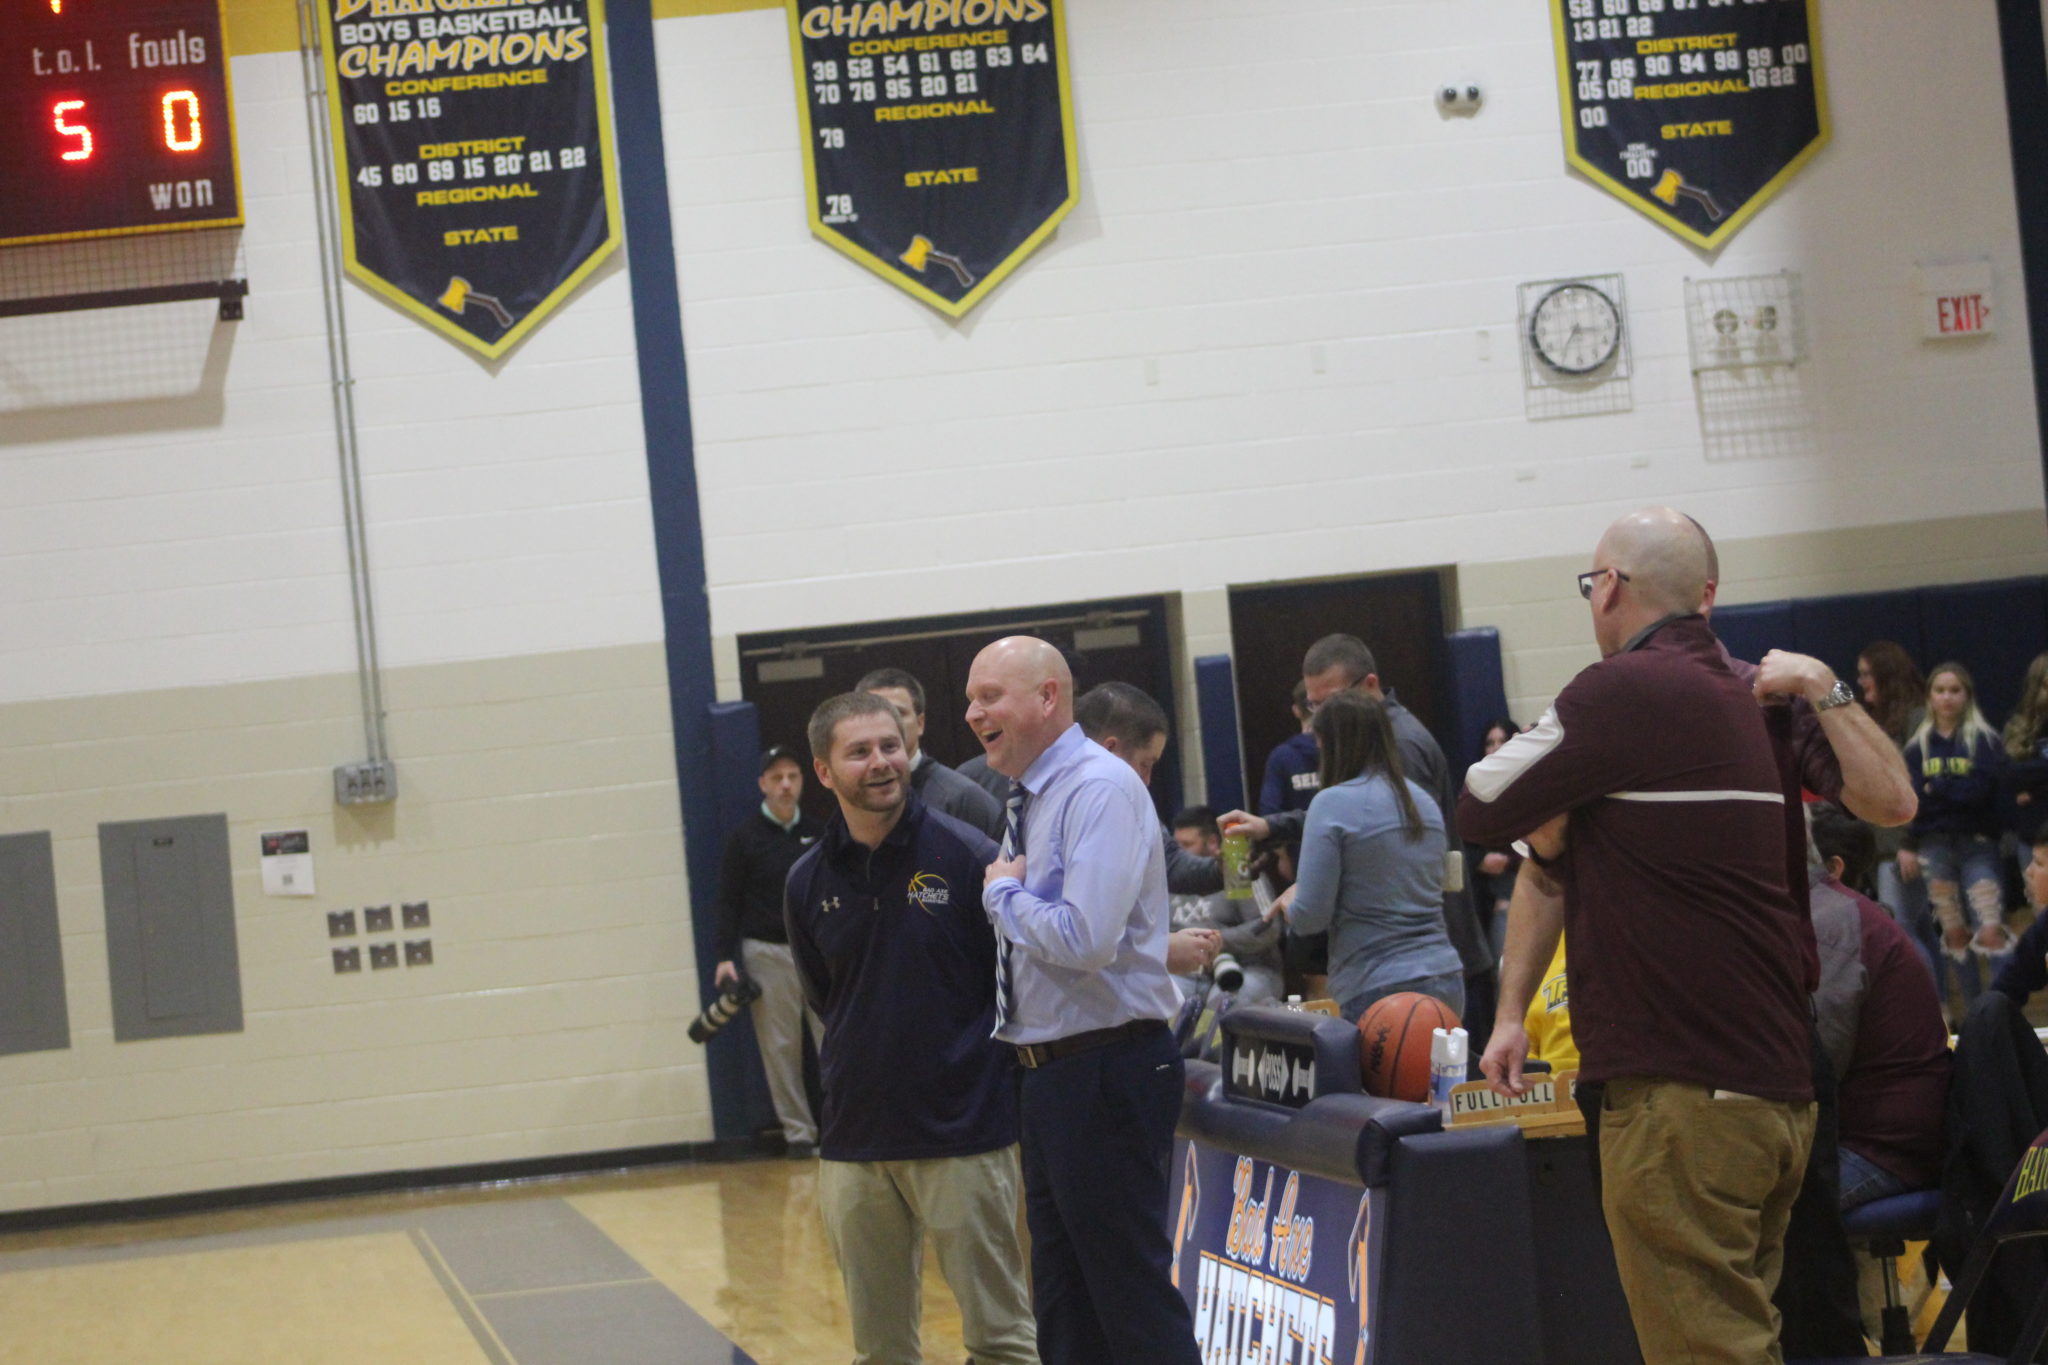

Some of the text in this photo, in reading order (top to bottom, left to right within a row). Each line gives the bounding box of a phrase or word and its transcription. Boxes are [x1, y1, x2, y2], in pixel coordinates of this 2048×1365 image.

[339, 19, 411, 45] BOYS
[418, 5, 582, 39] BASKETBALL
[801, 0, 1049, 39] CHAMPIONS
[1573, 16, 1654, 42] 13 21 22
[32, 29, 206, 76] t.o.l. fouls
[338, 26, 588, 79] CHAMPIONS
[848, 29, 1009, 56] CONFERENCE
[1636, 32, 1739, 54] DISTRICT
[846, 57, 874, 79] 52
[883, 54, 910, 76] 54
[1576, 60, 1602, 81] 77
[1769, 66, 1796, 86] 22
[385, 68, 548, 96] CONFERENCE
[814, 83, 841, 104] 70
[849, 80, 876, 102] 78
[921, 75, 947, 96] 20
[955, 72, 978, 94] 21
[1578, 80, 1604, 101] 05
[1633, 78, 1751, 101] REGIONAL
[353, 96, 442, 125] 60 15 16
[874, 99, 995, 122] REGIONAL
[1580, 105, 1608, 129] 00
[53, 90, 202, 161] 5 0
[1660, 120, 1733, 140] STATE
[418, 136, 526, 160] DISTRICT
[819, 128, 845, 148] 78
[357, 165, 382, 187] 45
[391, 162, 419, 185] 60
[462, 156, 486, 180] 15
[529, 150, 553, 173] 21
[559, 146, 587, 170] 22
[904, 167, 979, 187] STATE
[1626, 158, 1654, 179] 00
[149, 179, 214, 210] won
[416, 183, 538, 206] REGIONAL
[826, 194, 853, 215] 78
[443, 226, 519, 246] STATE
[1936, 295, 1982, 333] EXIT
[1455, 1090, 1500, 1112] FULL
[1226, 1156, 1274, 1265] Bad
